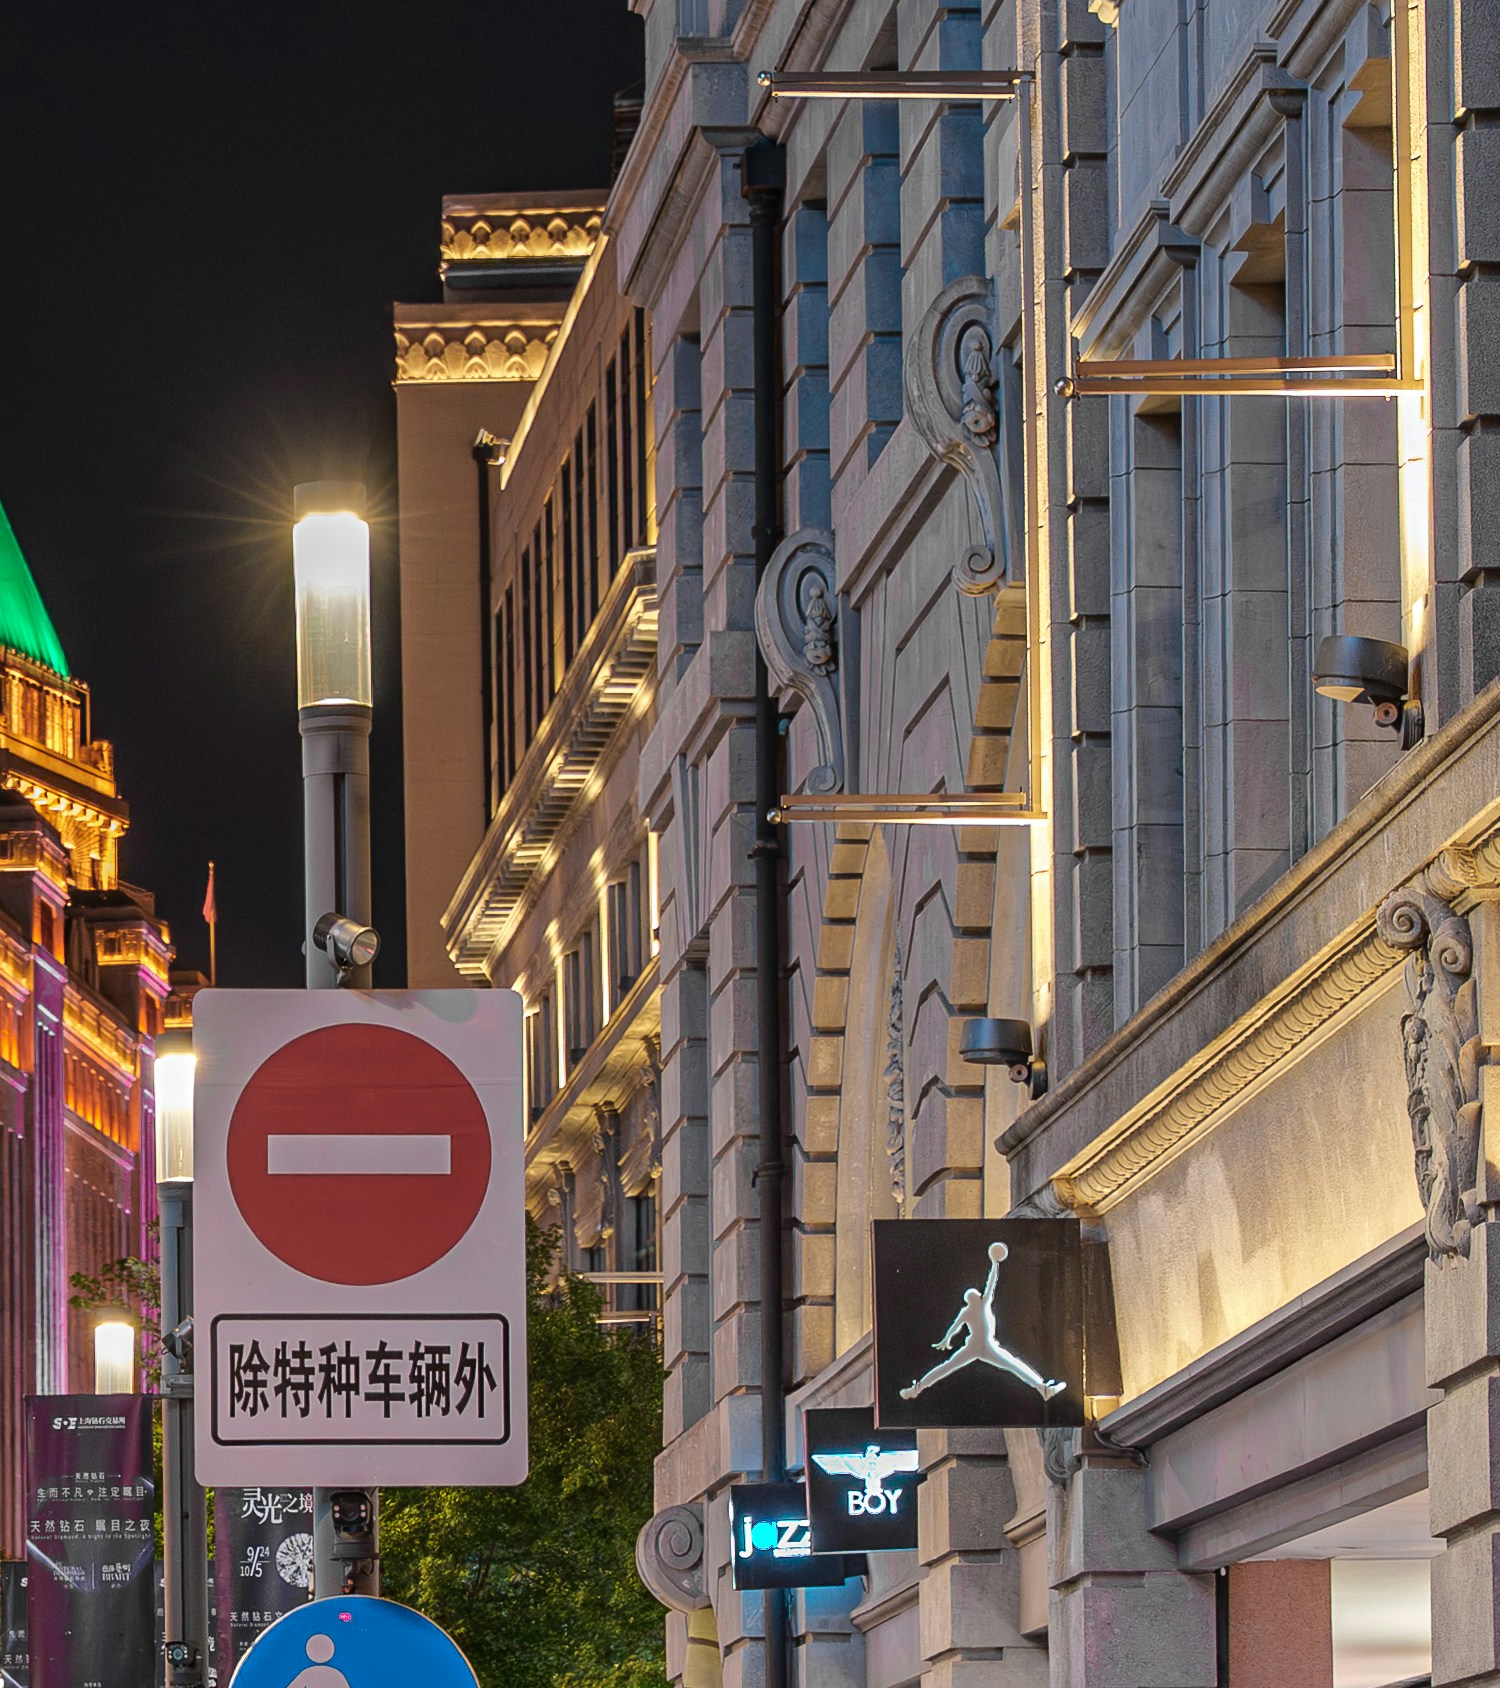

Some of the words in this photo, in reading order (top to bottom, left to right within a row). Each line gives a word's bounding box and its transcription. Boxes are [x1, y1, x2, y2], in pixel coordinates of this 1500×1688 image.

[228, 1339, 499, 1420] 除特种车辆外
[847, 1488, 902, 1516] BOY
[30, 1521, 85, 1533] 天然钻石
